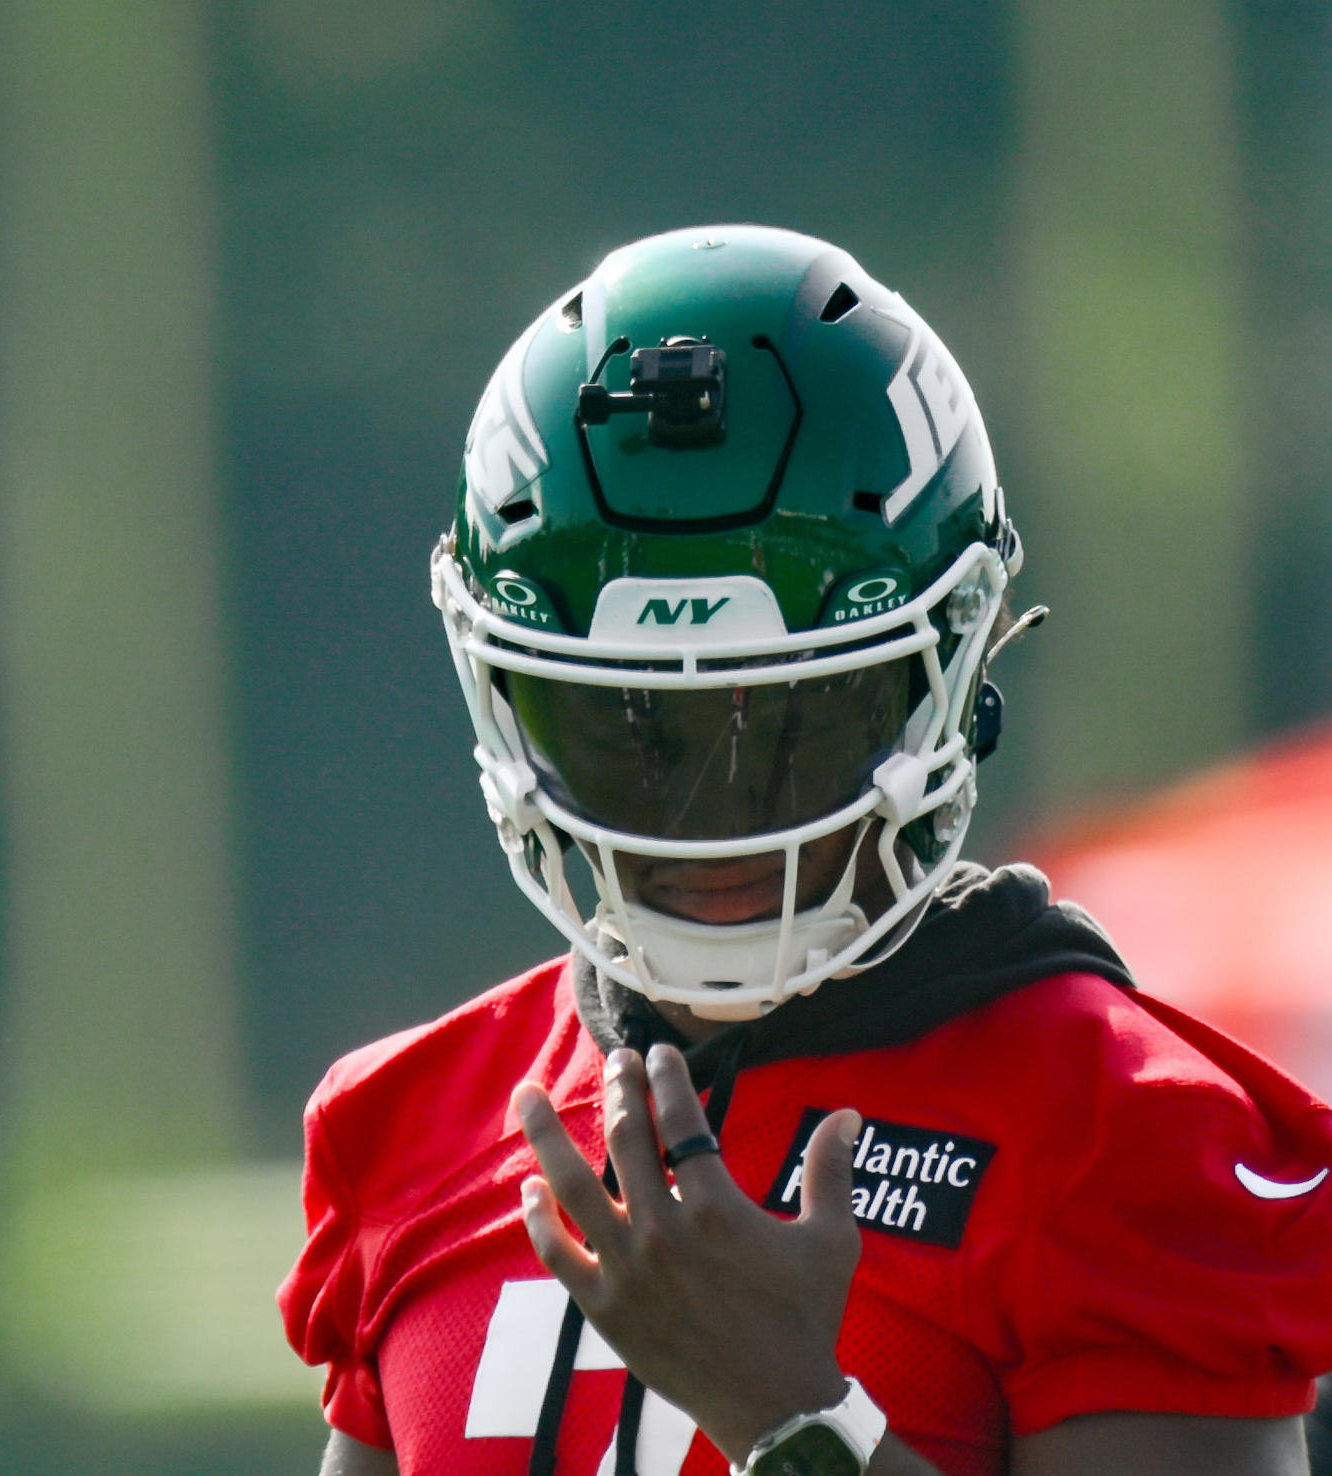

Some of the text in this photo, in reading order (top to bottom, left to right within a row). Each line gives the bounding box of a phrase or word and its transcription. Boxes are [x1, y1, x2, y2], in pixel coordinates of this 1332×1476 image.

[635, 597, 731, 625] NY
[834, 594, 907, 621] OAKLEY
[799, 1125, 977, 1188] lantic
